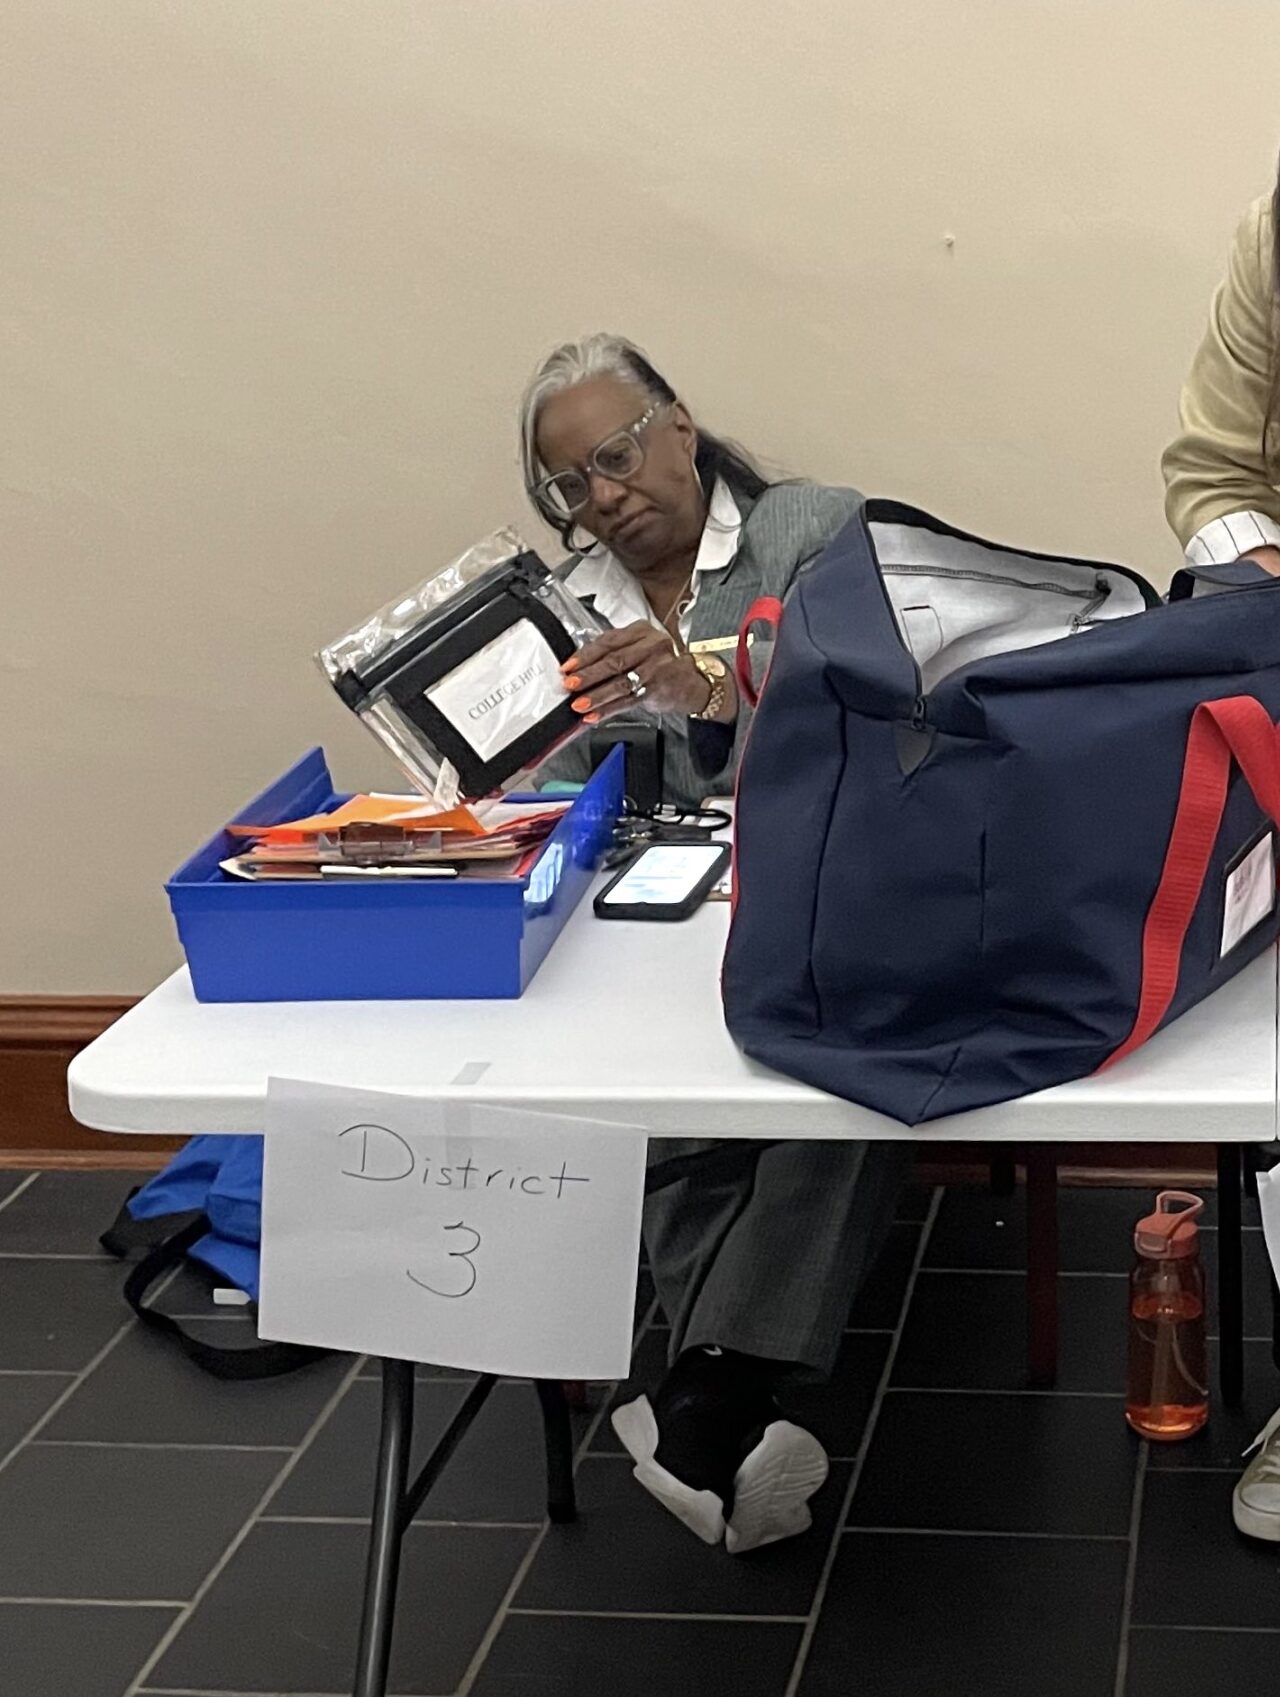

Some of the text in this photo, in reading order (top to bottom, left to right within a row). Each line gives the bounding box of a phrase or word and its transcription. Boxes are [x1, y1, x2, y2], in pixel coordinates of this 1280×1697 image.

[468, 682, 521, 721] COLLEGE
[338, 1123, 590, 1199] District
[406, 1220, 481, 1298] 3
